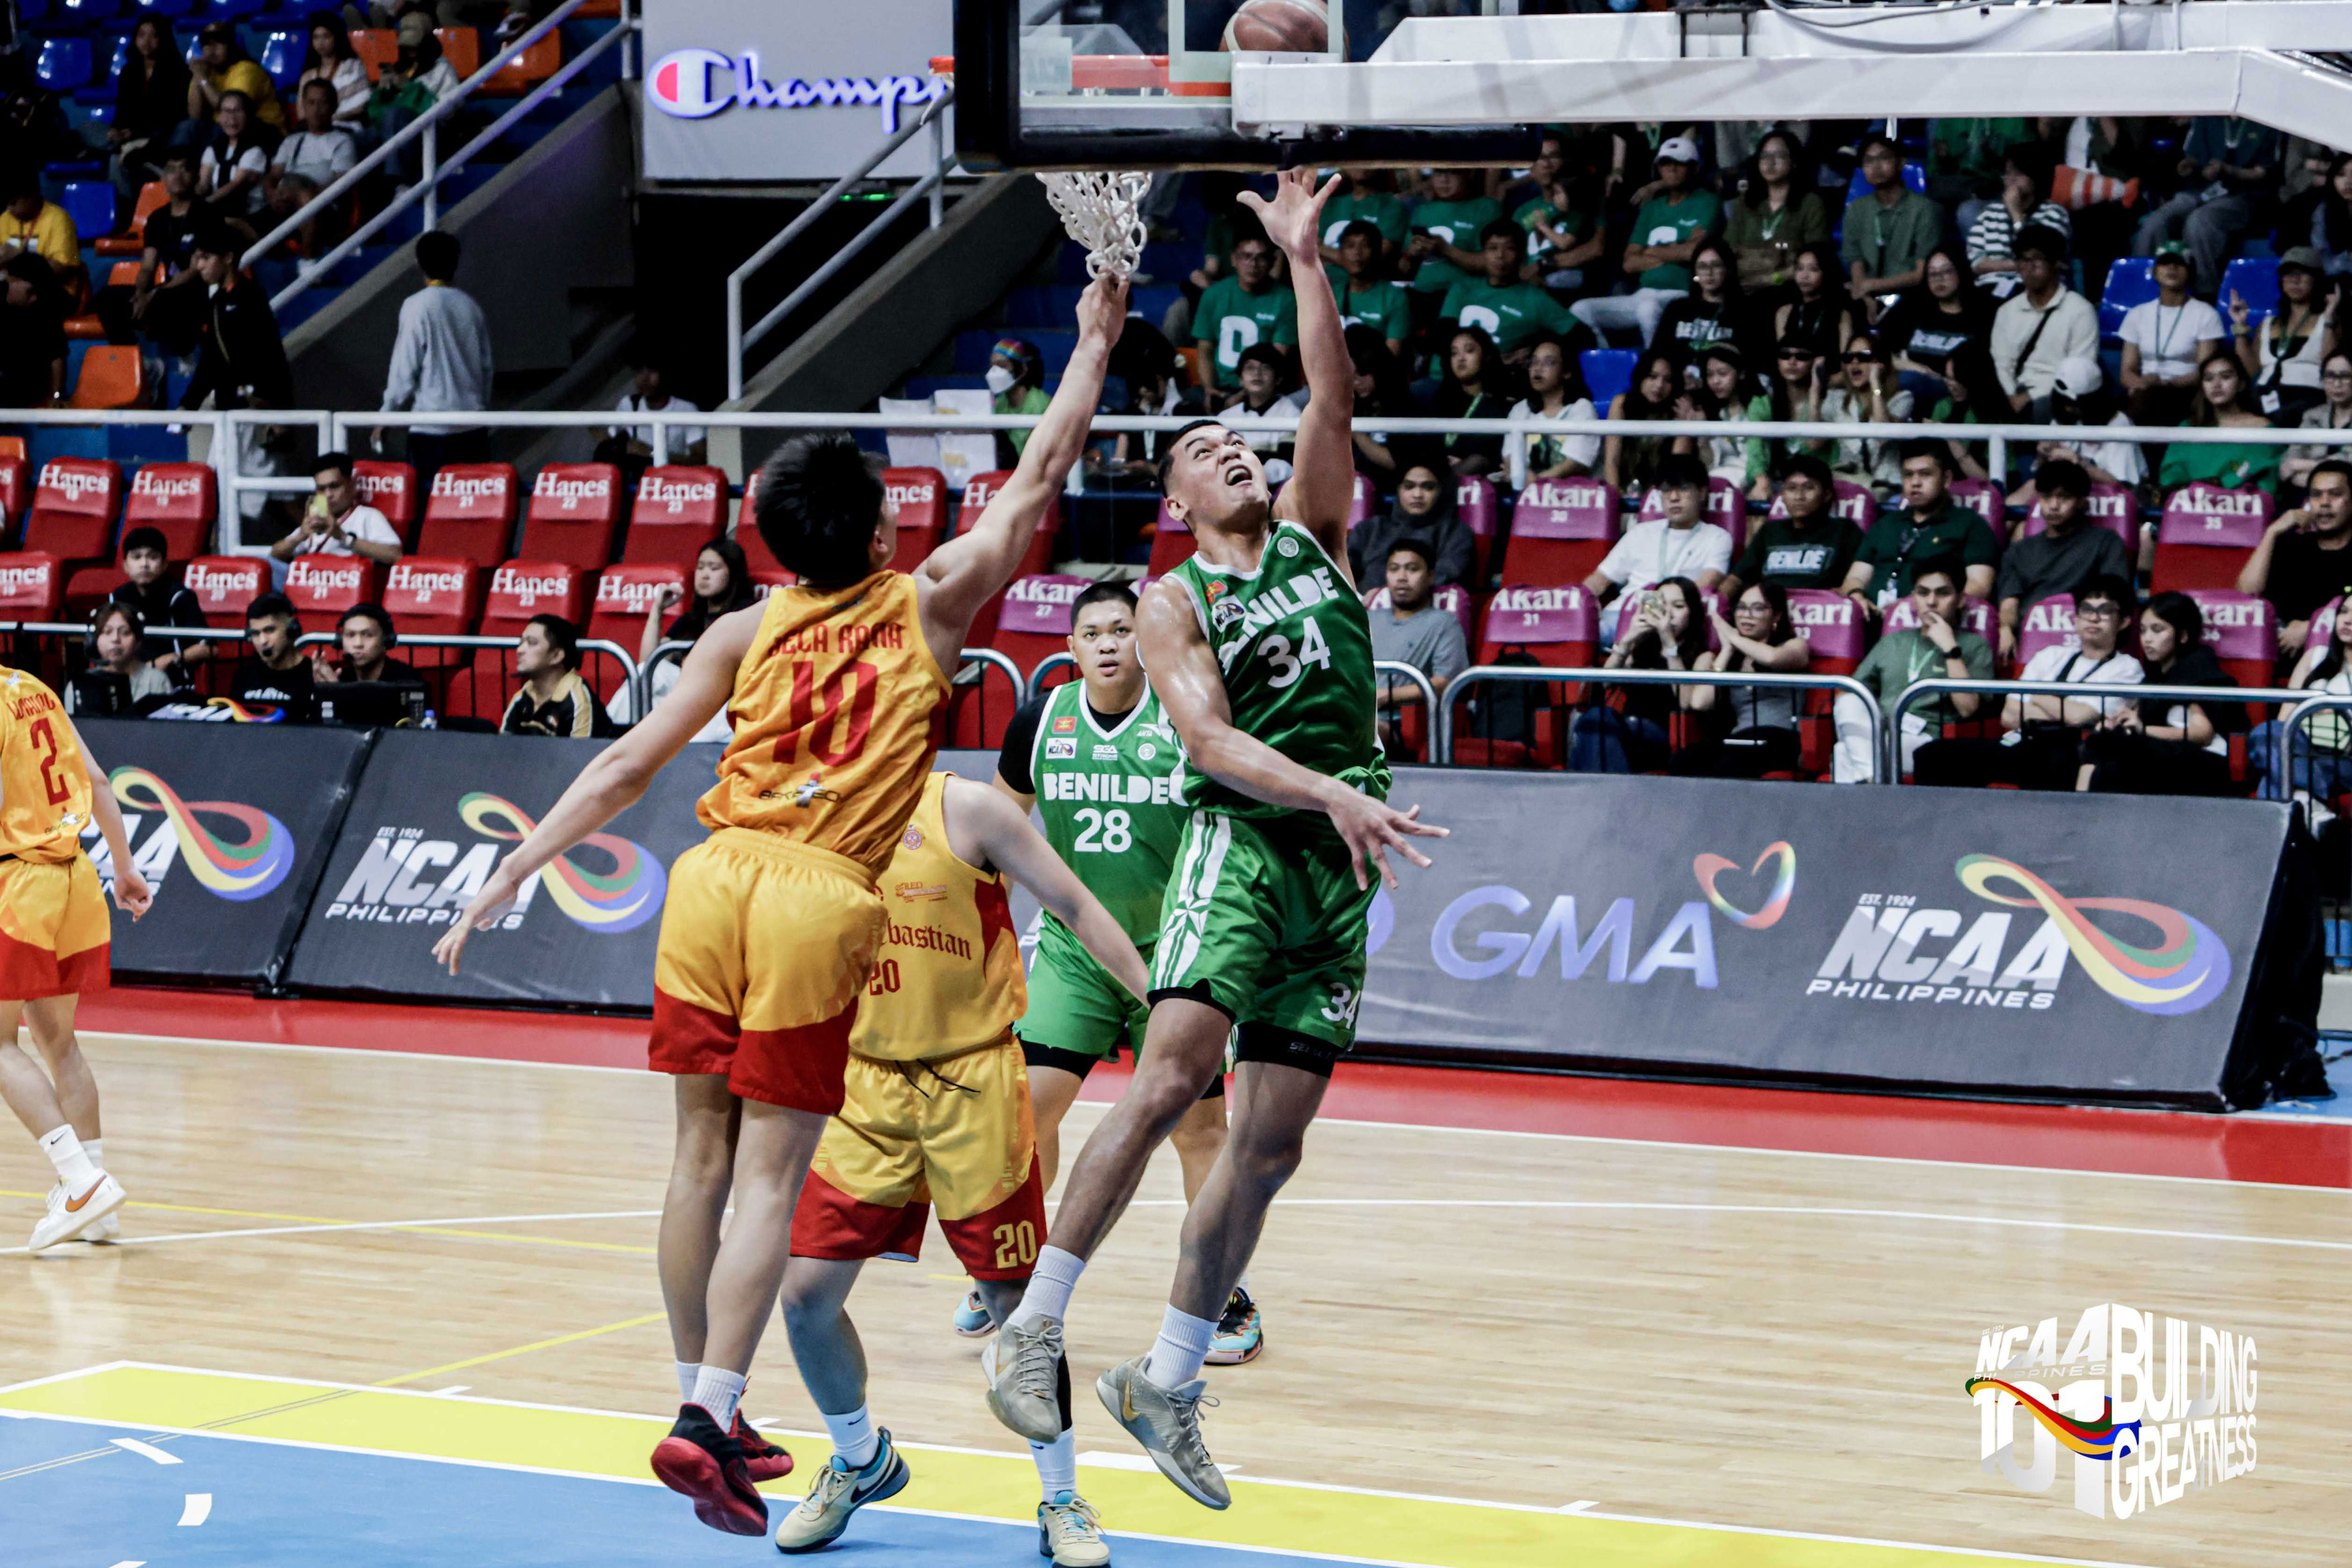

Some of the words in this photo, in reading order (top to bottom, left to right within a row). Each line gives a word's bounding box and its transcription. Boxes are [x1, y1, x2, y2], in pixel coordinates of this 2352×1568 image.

[38, 465, 110, 494] Hanes
[132, 471, 201, 495] Hanes
[352, 468, 404, 492] anes
[431, 473, 506, 496] Hanes
[534, 472, 609, 498] Hanes
[637, 477, 717, 501] Hanes
[1518, 482, 1606, 509] Akari
[2168, 487, 2263, 516] Akari
[184, 565, 258, 590] Hanes
[286, 561, 361, 588] Hanes
[387, 565, 464, 590] Hanes
[491, 569, 568, 596] Hanes
[1371, 586, 1457, 612] Ari
[1489, 586, 1581, 611] Akari
[1788, 599, 1853, 625] kari
[1523, 613, 1540, 626] 31
[769, 622, 828, 654] ELA
[1257, 616, 1331, 688] 34
[773, 660, 878, 768] 10
[30, 718, 71, 806] 2
[1043, 773, 1169, 804] BENILDE
[399, 827, 424, 838] 1924
[1073, 808, 1132, 852] 28
[1886, 894, 1917, 907] 1924
[882, 917, 972, 960] bastian
[1431, 885, 1719, 989] GMA
[1817, 906, 2070, 991] NCAA
[869, 959, 901, 996] 20
[1321, 982, 1361, 1030] 34
[1805, 979, 2056, 1009] PHILIPPINES
[993, 1220, 1037, 1269] 20
